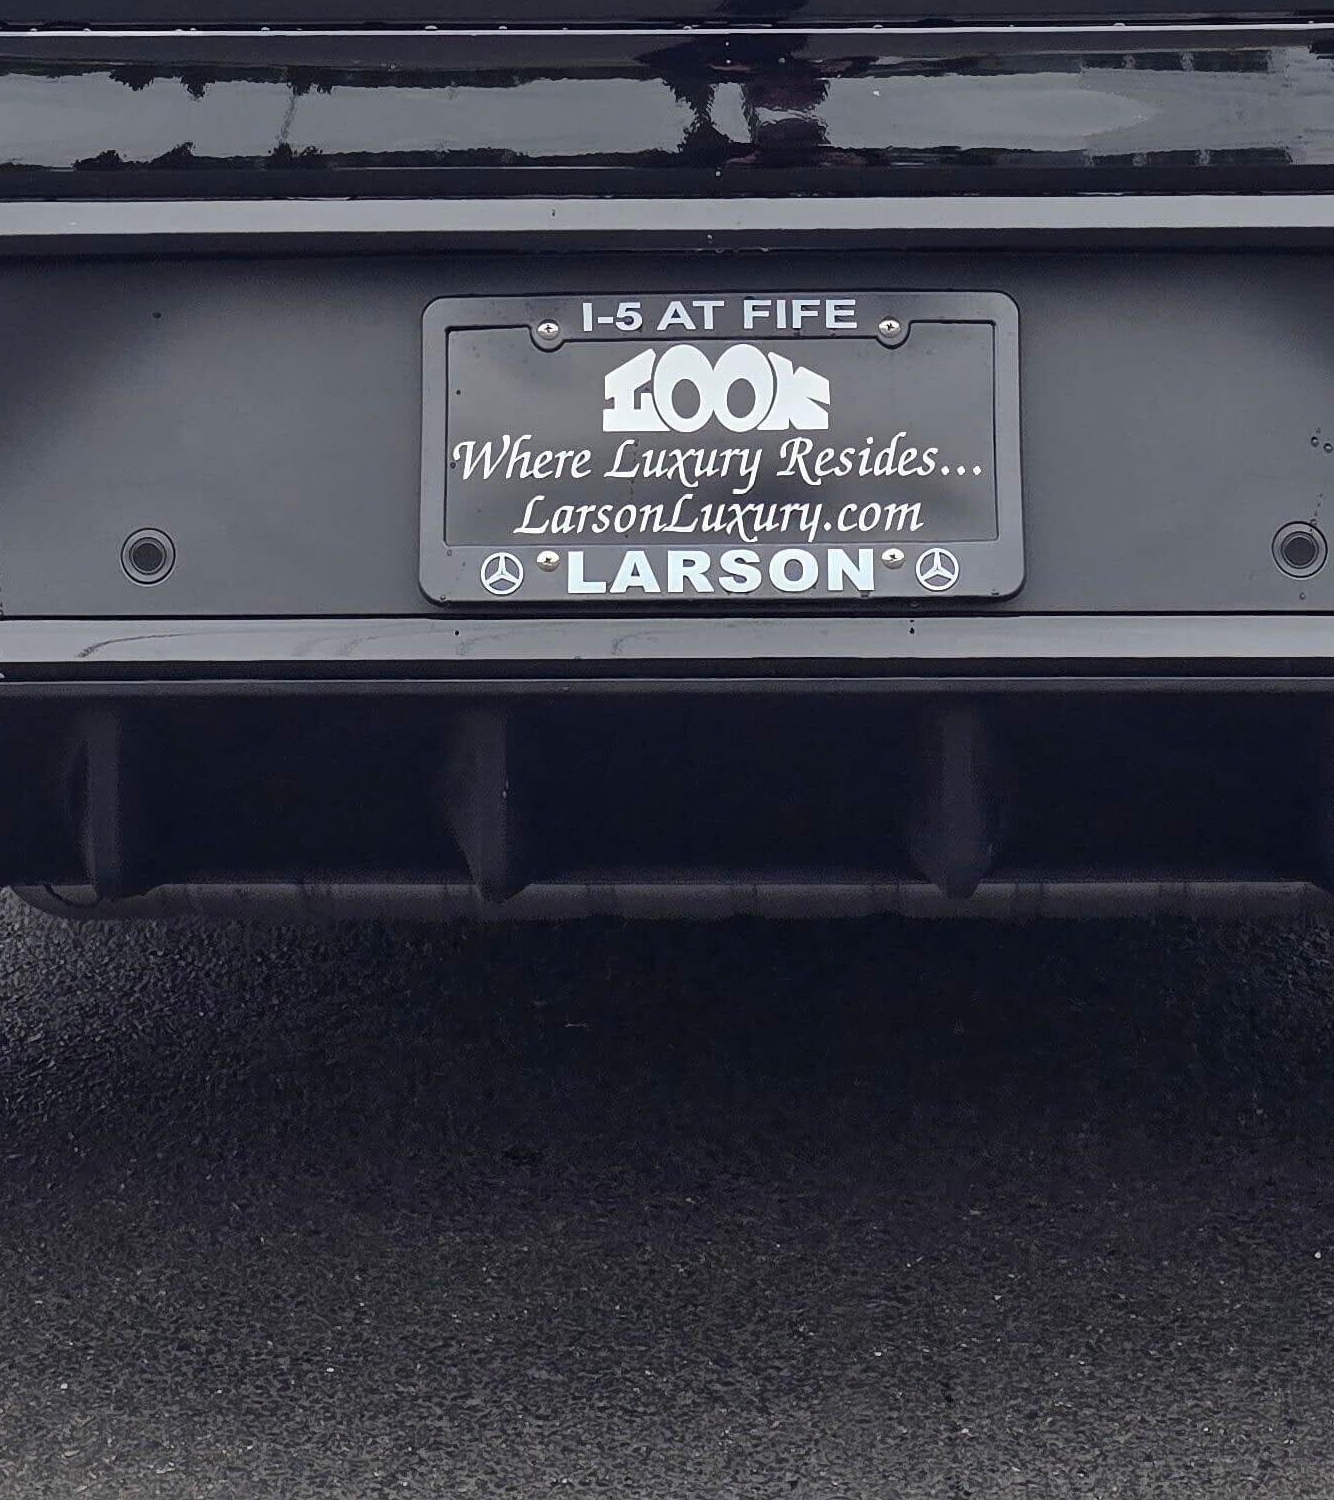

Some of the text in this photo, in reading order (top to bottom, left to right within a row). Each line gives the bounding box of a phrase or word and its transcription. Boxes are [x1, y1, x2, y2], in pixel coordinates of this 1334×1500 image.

[582, 299, 859, 332] I-5 AT FIFE
[452, 431, 983, 495] Where Luxury Resides...
[513, 494, 925, 542] LarsonLuxury.com
[567, 548, 875, 594] LARSON
